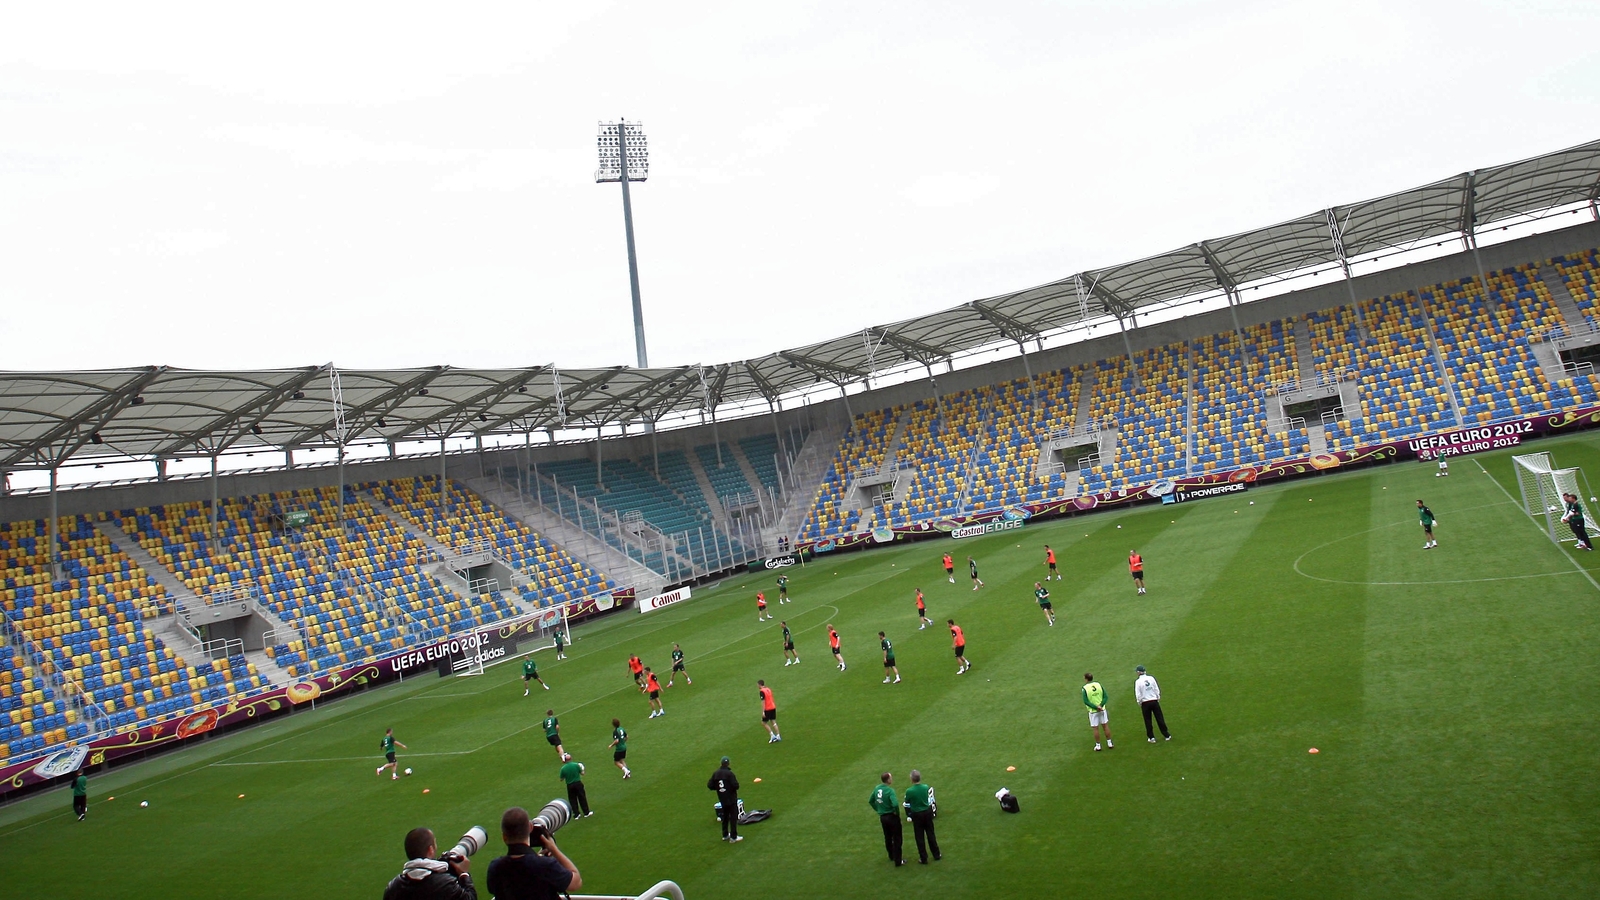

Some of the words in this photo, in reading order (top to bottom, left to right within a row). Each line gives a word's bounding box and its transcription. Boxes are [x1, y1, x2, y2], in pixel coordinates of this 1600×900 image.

[1408, 435, 1449, 451] UEFA
[1449, 427, 1492, 444] EURO
[1493, 420, 1534, 437] 2012
[1432, 446, 1460, 458] UEFA
[1461, 441, 1490, 453] EURO
[1492, 436, 1520, 448] 2012
[1190, 482, 1245, 498] POWERADE
[959, 525, 985, 537] Castrol
[985, 519, 1024, 533] EDGE
[764, 556, 795, 569] Carlsberg
[241, 603, 247, 613] 9
[651, 591, 682, 608] Canon
[391, 651, 425, 671] UEFA
[426, 641, 460, 661] EURO
[461, 632, 489, 651] 2012
[474, 646, 506, 664] adidas
